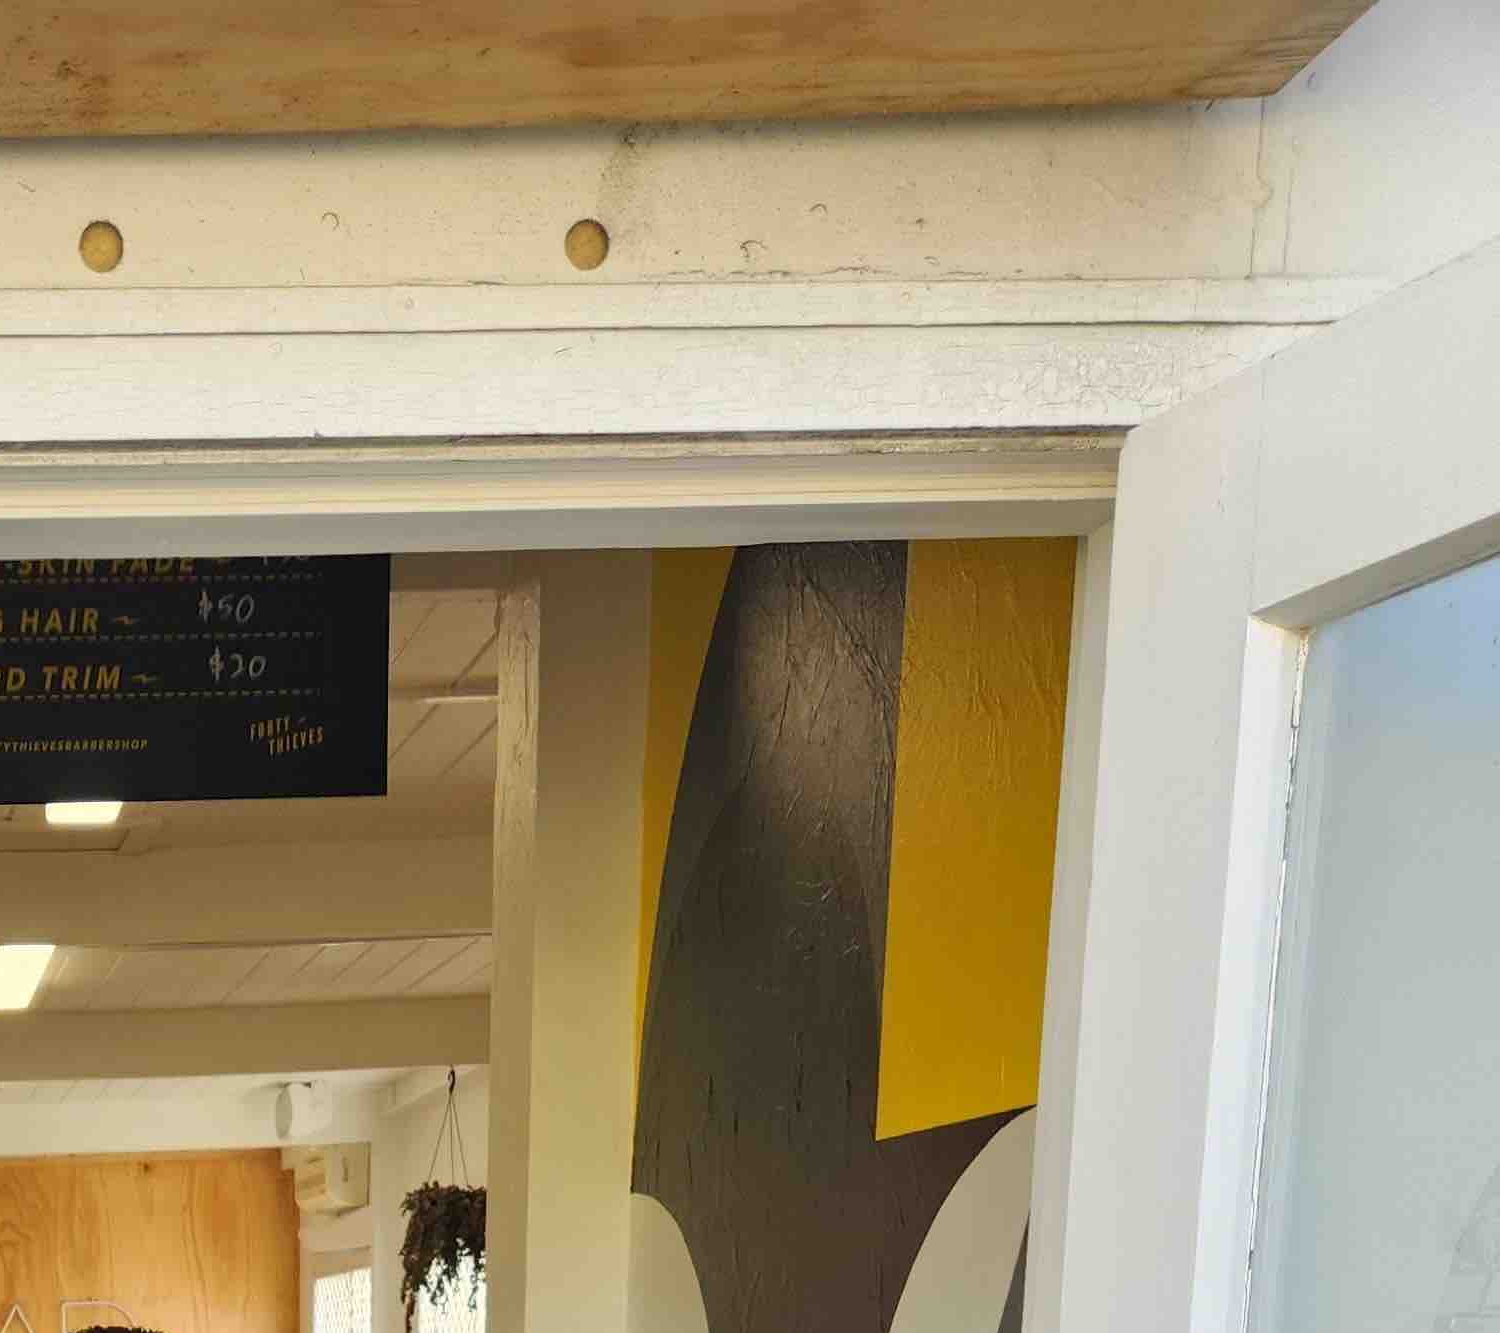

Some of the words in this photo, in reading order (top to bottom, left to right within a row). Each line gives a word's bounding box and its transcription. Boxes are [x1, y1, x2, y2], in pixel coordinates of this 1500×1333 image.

[20, 607, 102, 633] HAIR
[197, 587, 256, 623] $50
[43, 664, 123, 691] TRIM
[209, 646, 267, 682] $20
